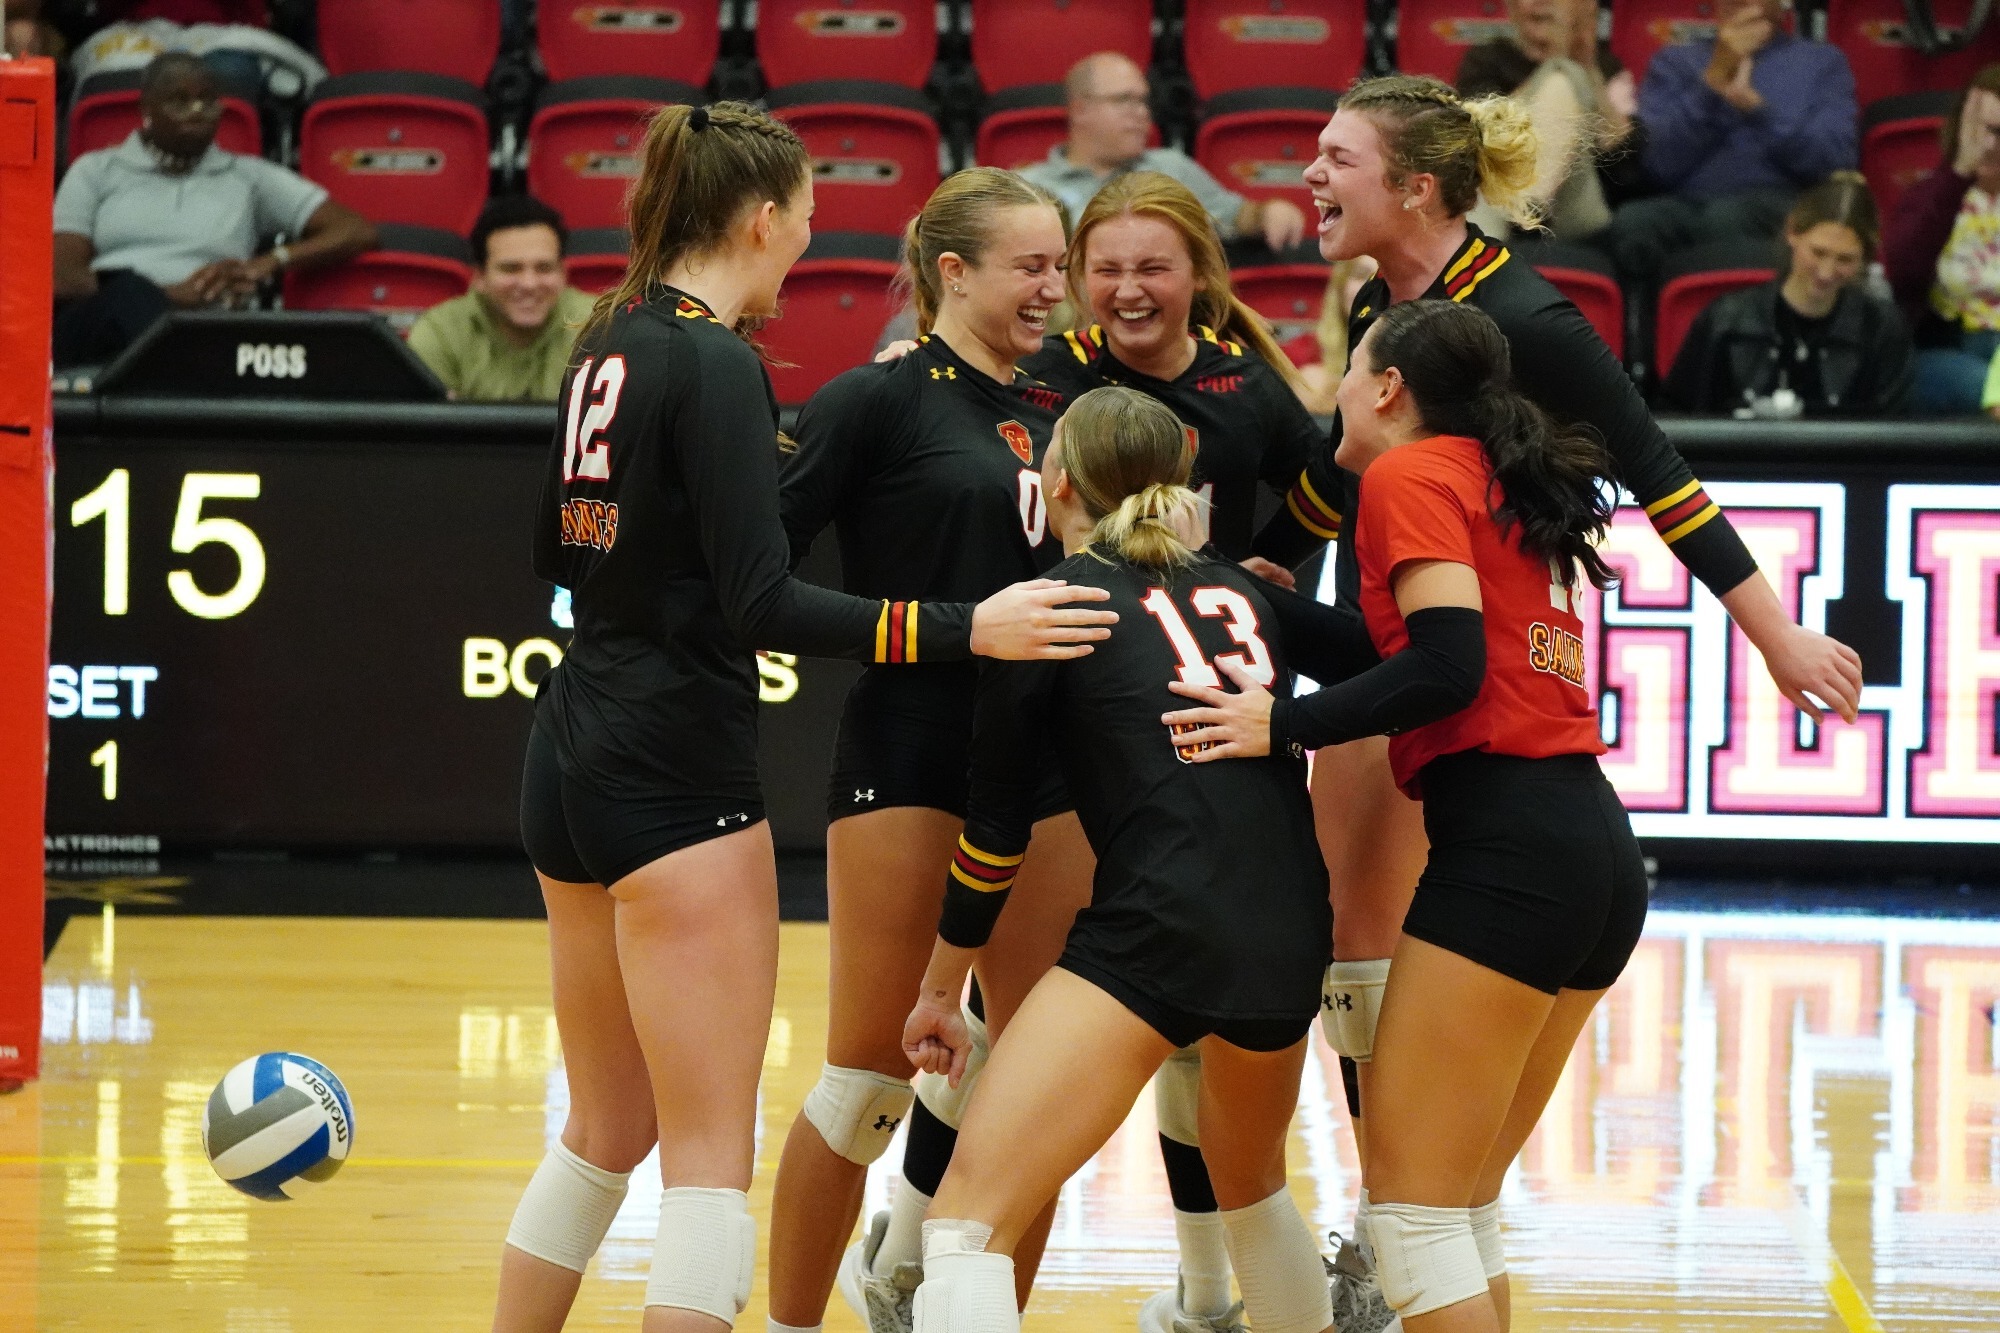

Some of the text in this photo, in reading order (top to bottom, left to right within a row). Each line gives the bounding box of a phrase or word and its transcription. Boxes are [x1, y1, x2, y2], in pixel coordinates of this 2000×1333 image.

[236, 344, 306, 379] POSS
[563, 354, 627, 484] 12
[70, 467, 267, 620] 15
[1139, 586, 1277, 689] 13
[1529, 622, 1588, 693] SAIN
[48, 664, 159, 719] SET
[90, 740, 118, 801] 1
[302, 1073, 347, 1143] molten
